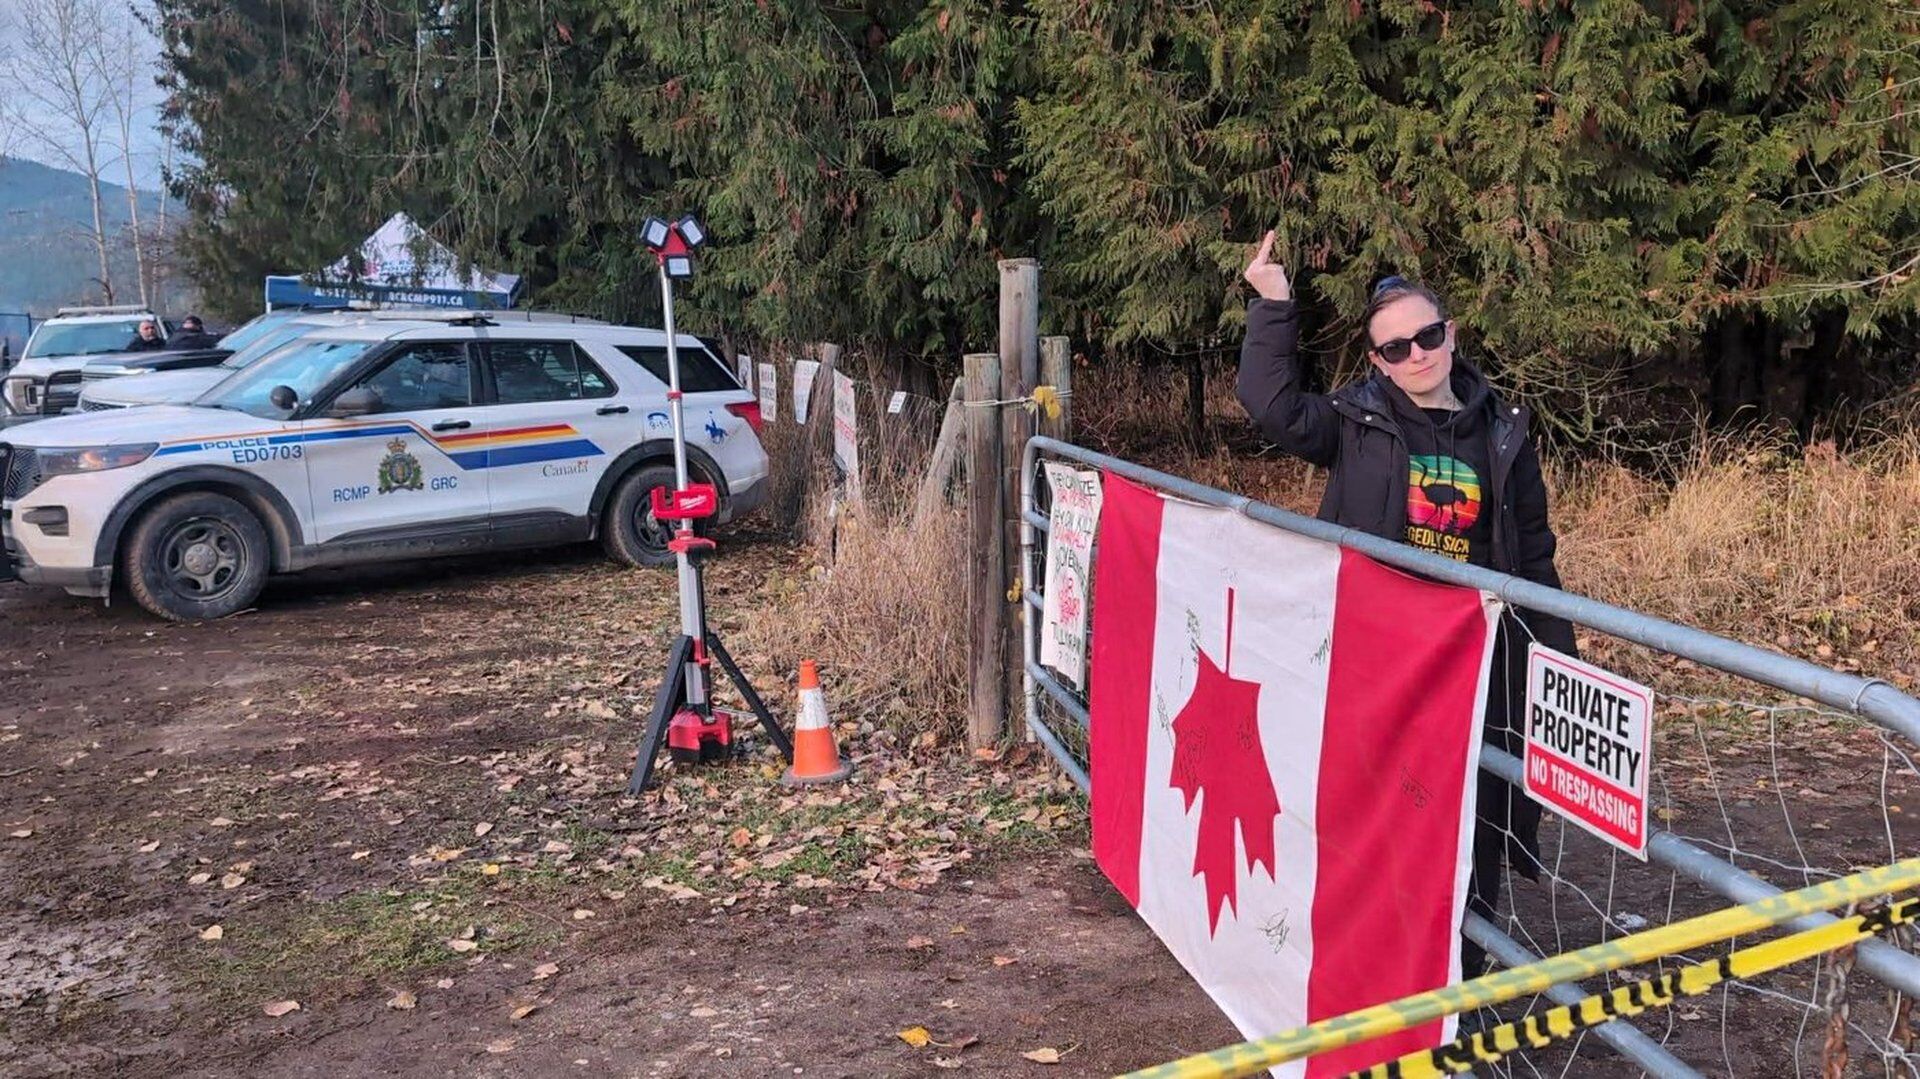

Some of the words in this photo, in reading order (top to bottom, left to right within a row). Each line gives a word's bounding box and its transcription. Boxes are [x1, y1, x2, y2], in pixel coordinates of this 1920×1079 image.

[202, 437, 268, 450] POLICE
[232, 444, 303, 464] ED0703
[542, 462, 590, 478] Canada
[333, 485, 371, 503] RCMP
[431, 476, 458, 491] GRC
[1543, 666, 1631, 739] PRIVATE
[1531, 703, 1641, 788] PROPERTY
[1531, 753, 1548, 786] NO
[1551, 764, 1638, 835] TRESPASSING
